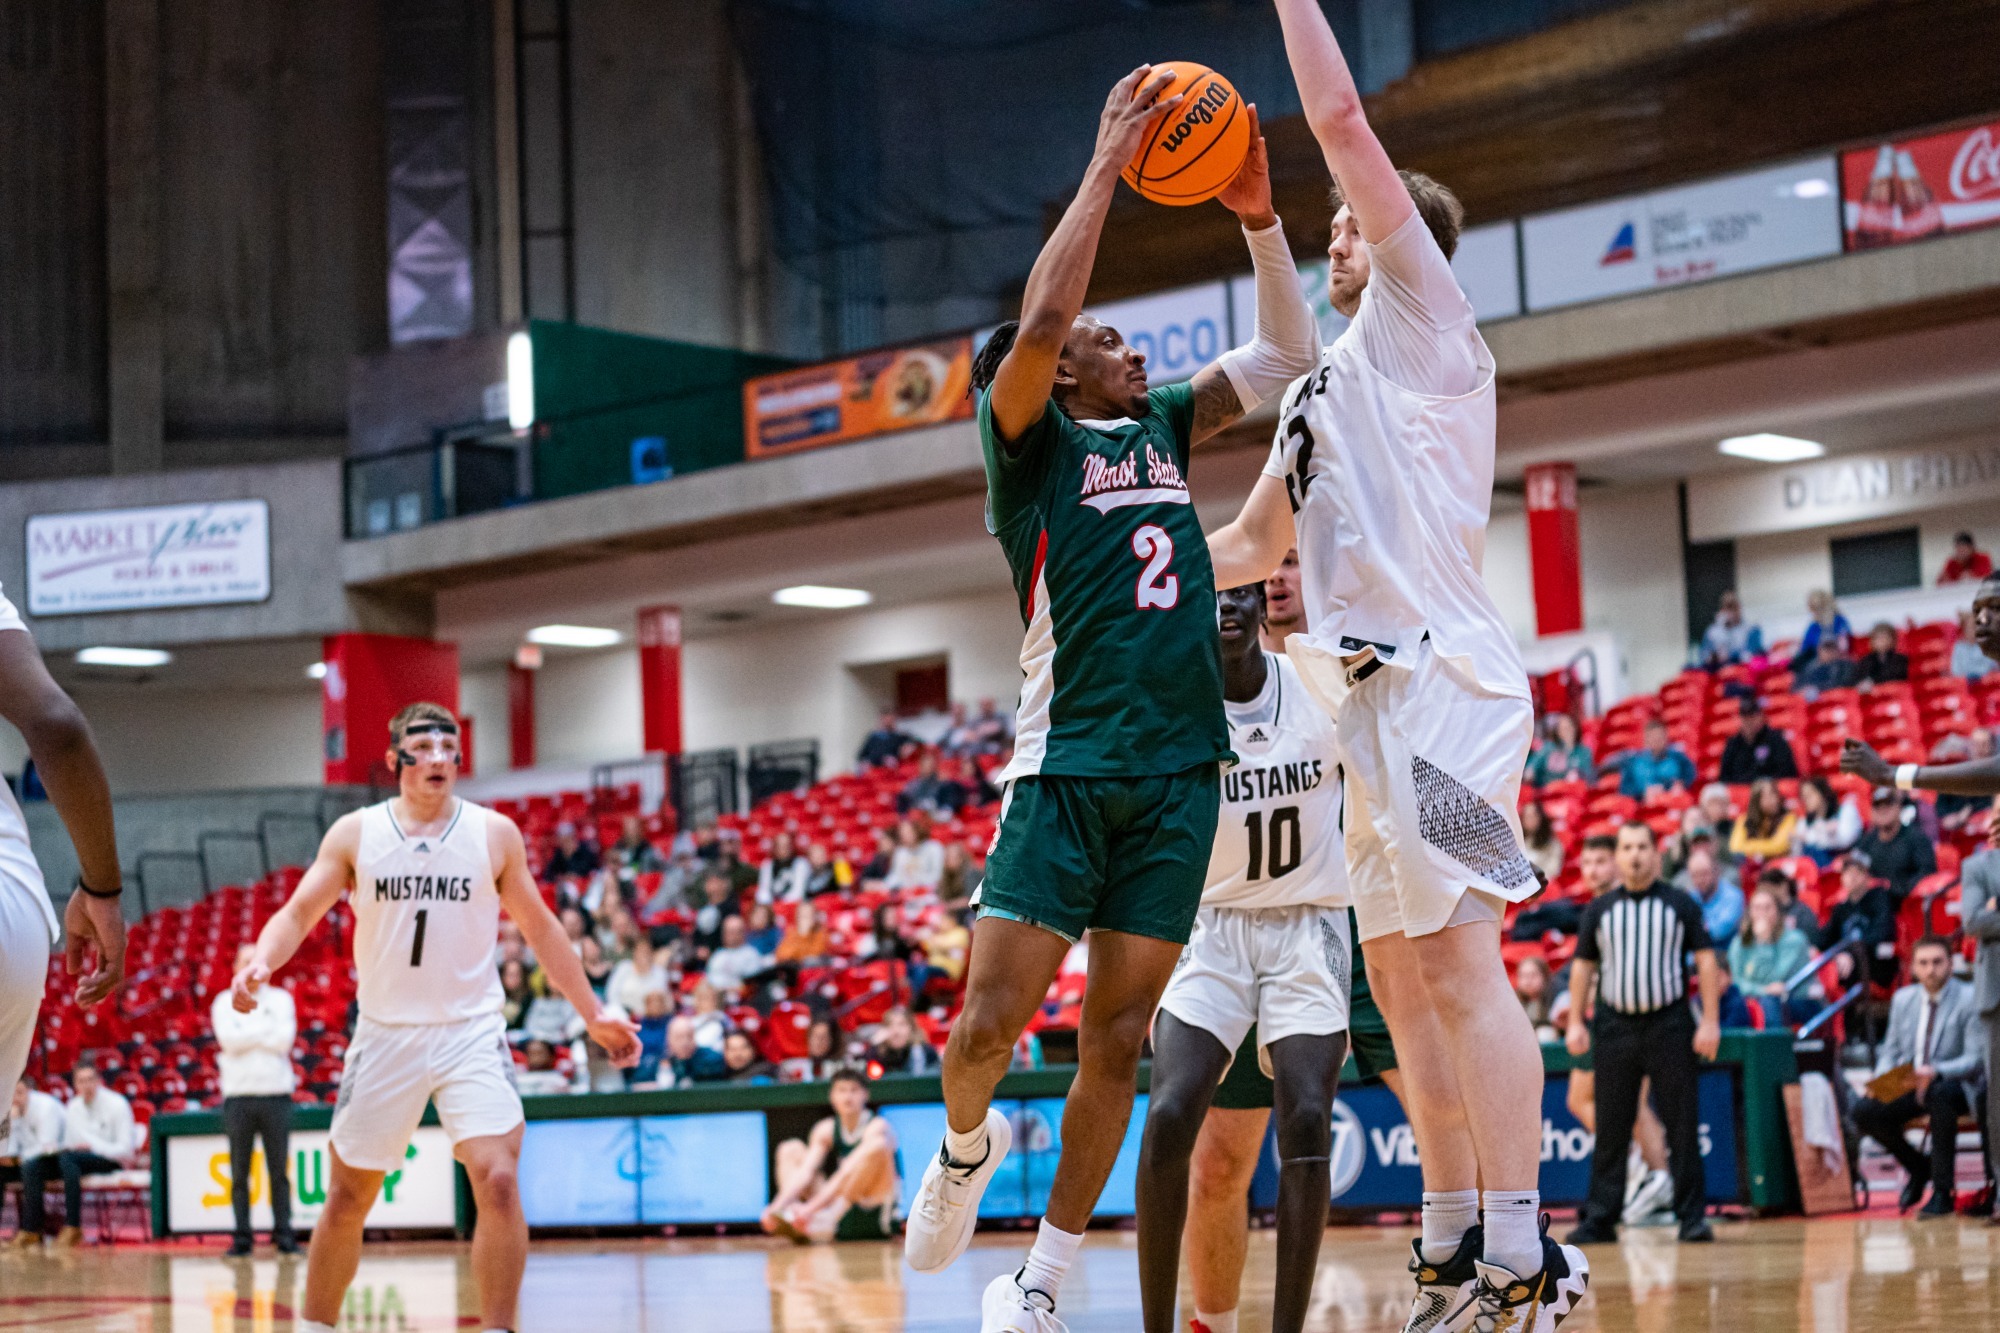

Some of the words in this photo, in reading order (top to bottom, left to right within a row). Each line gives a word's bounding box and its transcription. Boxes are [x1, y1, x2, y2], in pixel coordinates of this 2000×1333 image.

[1161, 82, 1231, 153] Wilson
[1080, 450, 1139, 495] Minot
[1146, 442, 1188, 489] State
[34, 520, 156, 556] MARKET
[1131, 522, 1181, 611] 2
[1221, 759, 1322, 804] USTANGS
[1244, 805, 1302, 881] 10
[375, 875, 471, 902] MUSTANGS
[410, 909, 427, 967] 1
